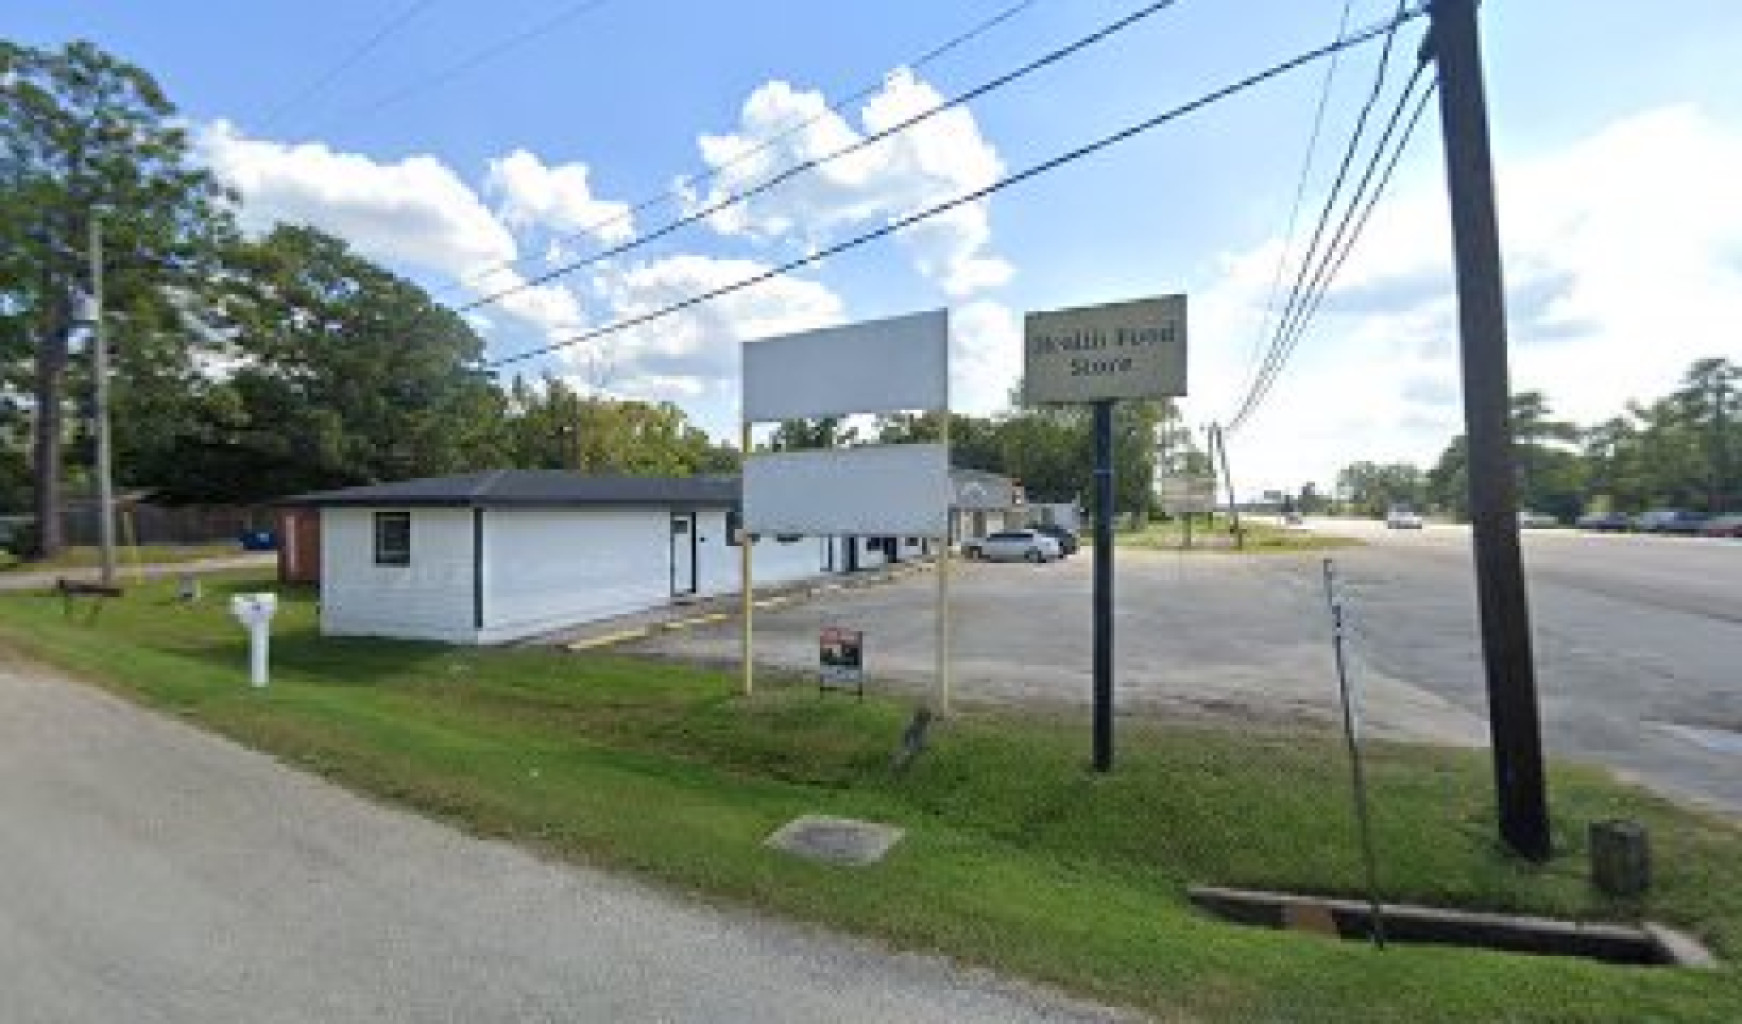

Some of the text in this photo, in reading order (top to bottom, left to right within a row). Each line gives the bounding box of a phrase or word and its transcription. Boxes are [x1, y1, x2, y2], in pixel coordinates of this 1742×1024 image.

[1033, 321, 1175, 355] Health Food
[1071, 358, 1133, 376] Store
